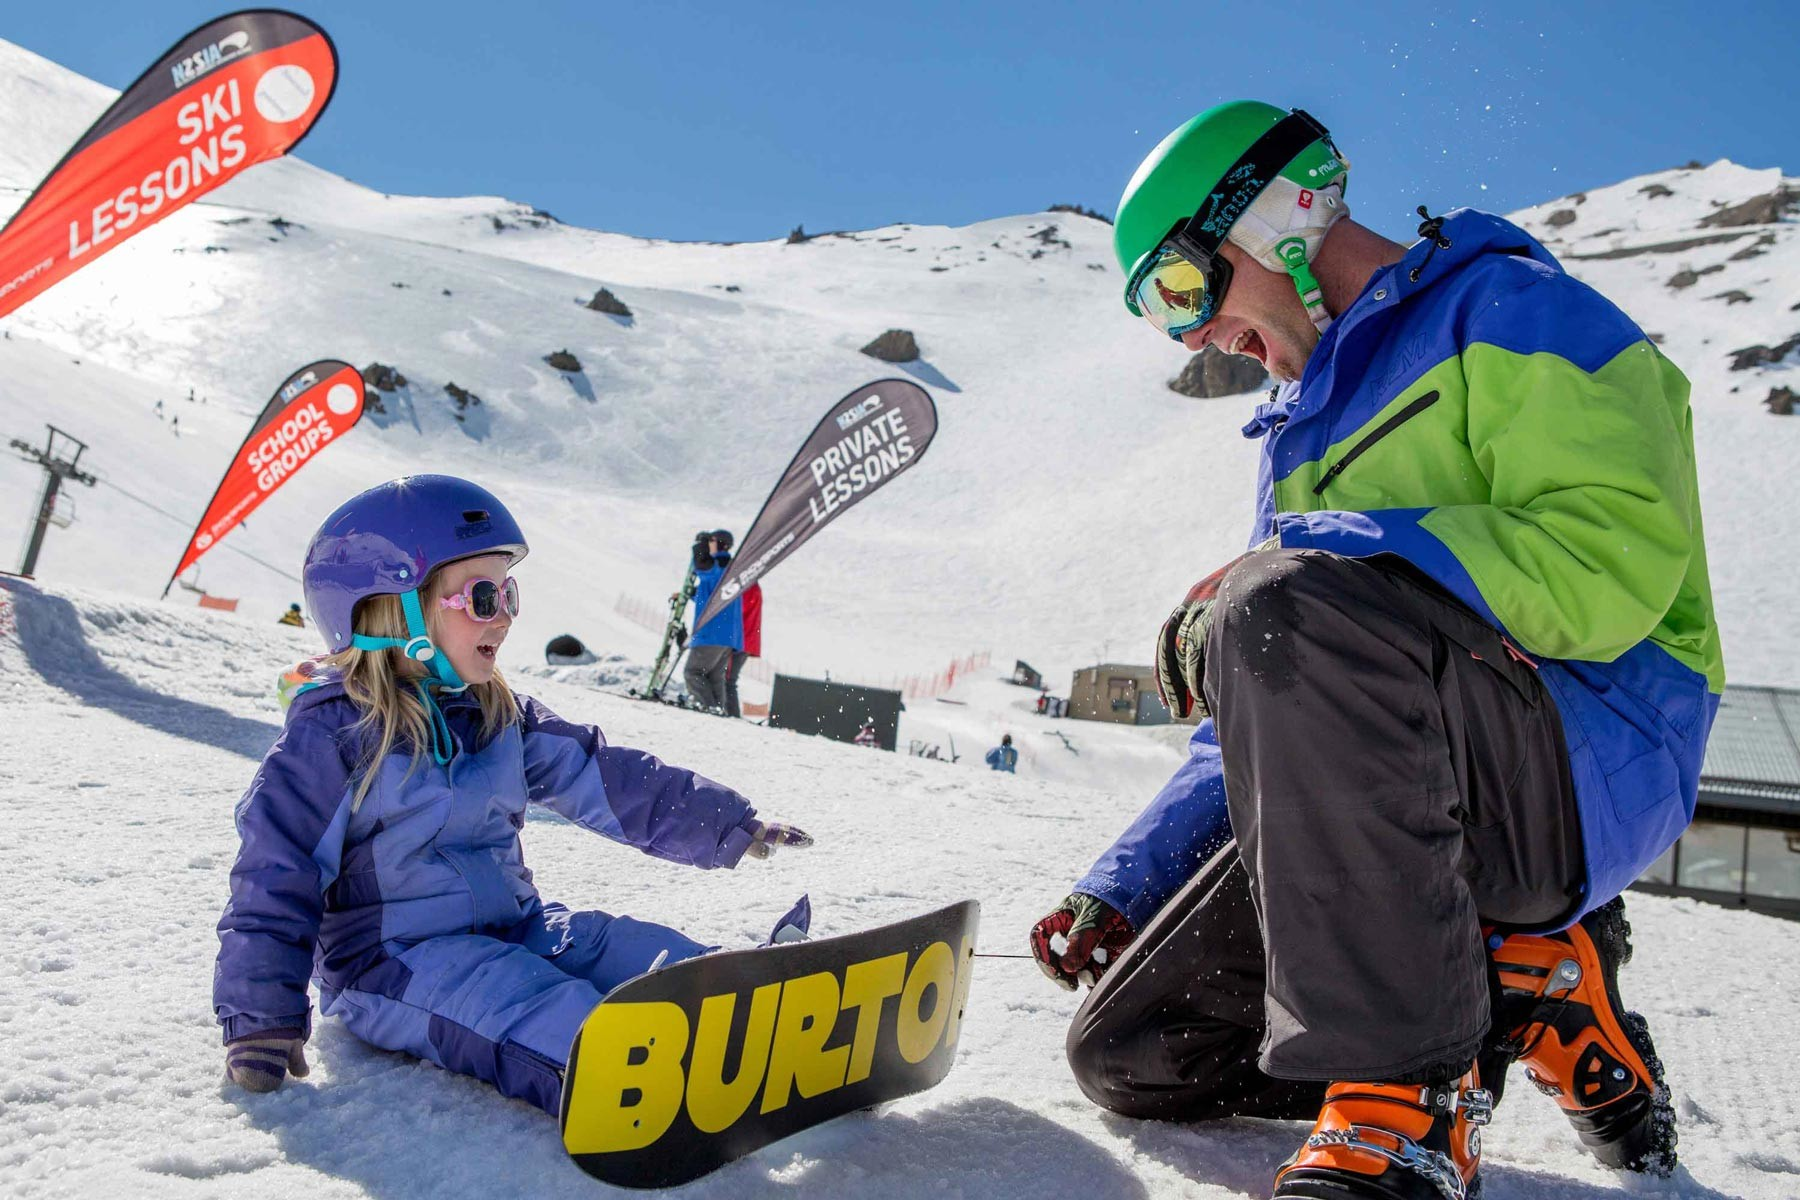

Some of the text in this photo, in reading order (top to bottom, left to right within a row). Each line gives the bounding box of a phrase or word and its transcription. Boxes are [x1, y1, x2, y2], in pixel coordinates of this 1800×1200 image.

[171, 43, 222, 81] NZSIA
[176, 78, 242, 145] SKI
[68, 124, 247, 260] LESSONS
[247, 402, 325, 474] SCHOOL
[257, 420, 334, 492] GROUPS
[810, 407, 908, 487] PRIVATE
[808, 435, 916, 524] LESSONS
